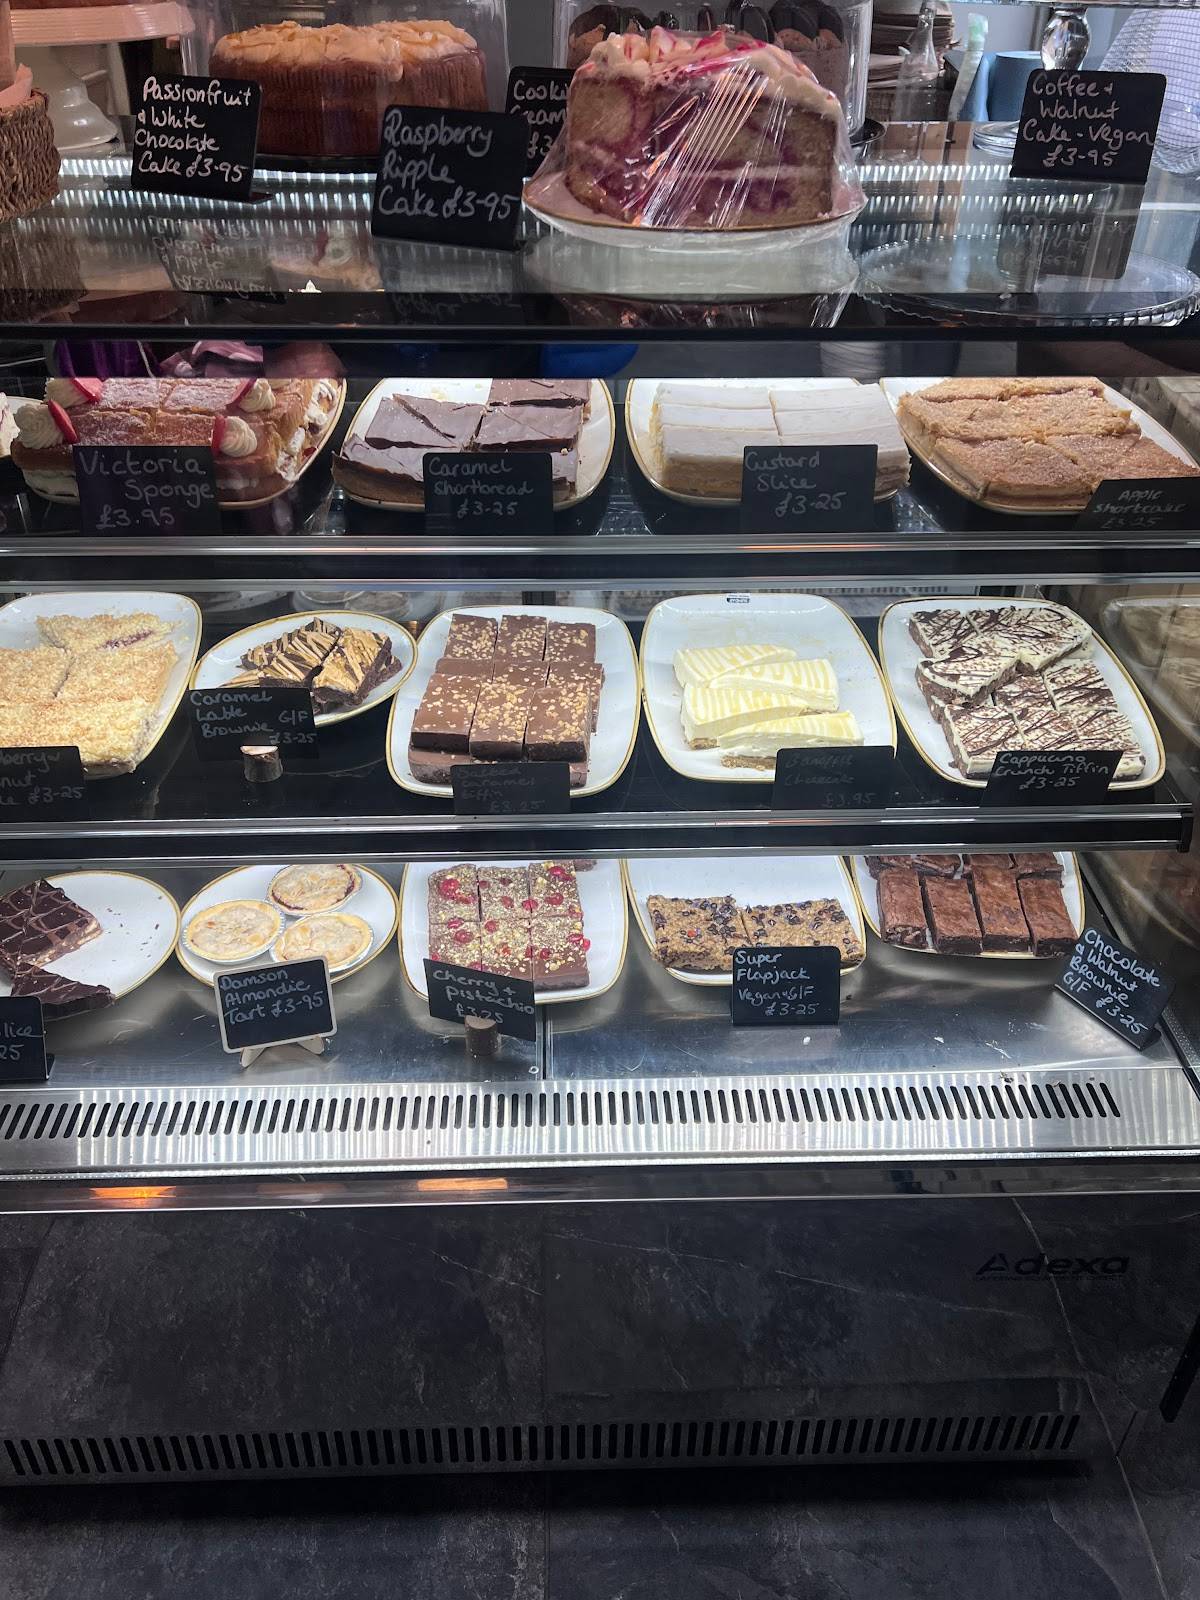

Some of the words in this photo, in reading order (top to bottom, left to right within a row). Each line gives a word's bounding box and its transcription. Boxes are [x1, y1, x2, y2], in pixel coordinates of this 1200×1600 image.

[143, 76, 251, 106] Passionfruit
[1033, 72, 1100, 97] Coffee
[152, 105, 205, 129] White
[1040, 99, 1119, 120] Walnut
[135, 128, 219, 153] Chocolate
[384, 108, 493, 157] Raspberry
[1023, 118, 1071, 143] Cake
[138, 150, 181, 175] Cake
[383, 149, 455, 190] Ripple
[379, 185, 438, 217] Cake
[79, 449, 206, 475] Victoria
[429, 457, 512, 477] Caramel
[745, 450, 820, 471] Custard
[125, 479, 214, 508] Sponge
[434, 479, 534, 496] Shortbread
[757, 473, 816, 491] Slice
[96, 504, 175, 529] £3.95
[190, 691, 273, 706] Caramel
[201, 720, 274, 738] Brownie
[1063, 761, 1109, 774] Tiffin
[735, 950, 782, 967] Super
[1084, 929, 1160, 987] Chocolate
[220, 969, 288, 990] Damson
[737, 966, 810, 984] Flapjack
[1087, 949, 1138, 992] Walnut
[224, 1003, 265, 1024] Tart
[976, 1253, 1129, 1274] Adexa
